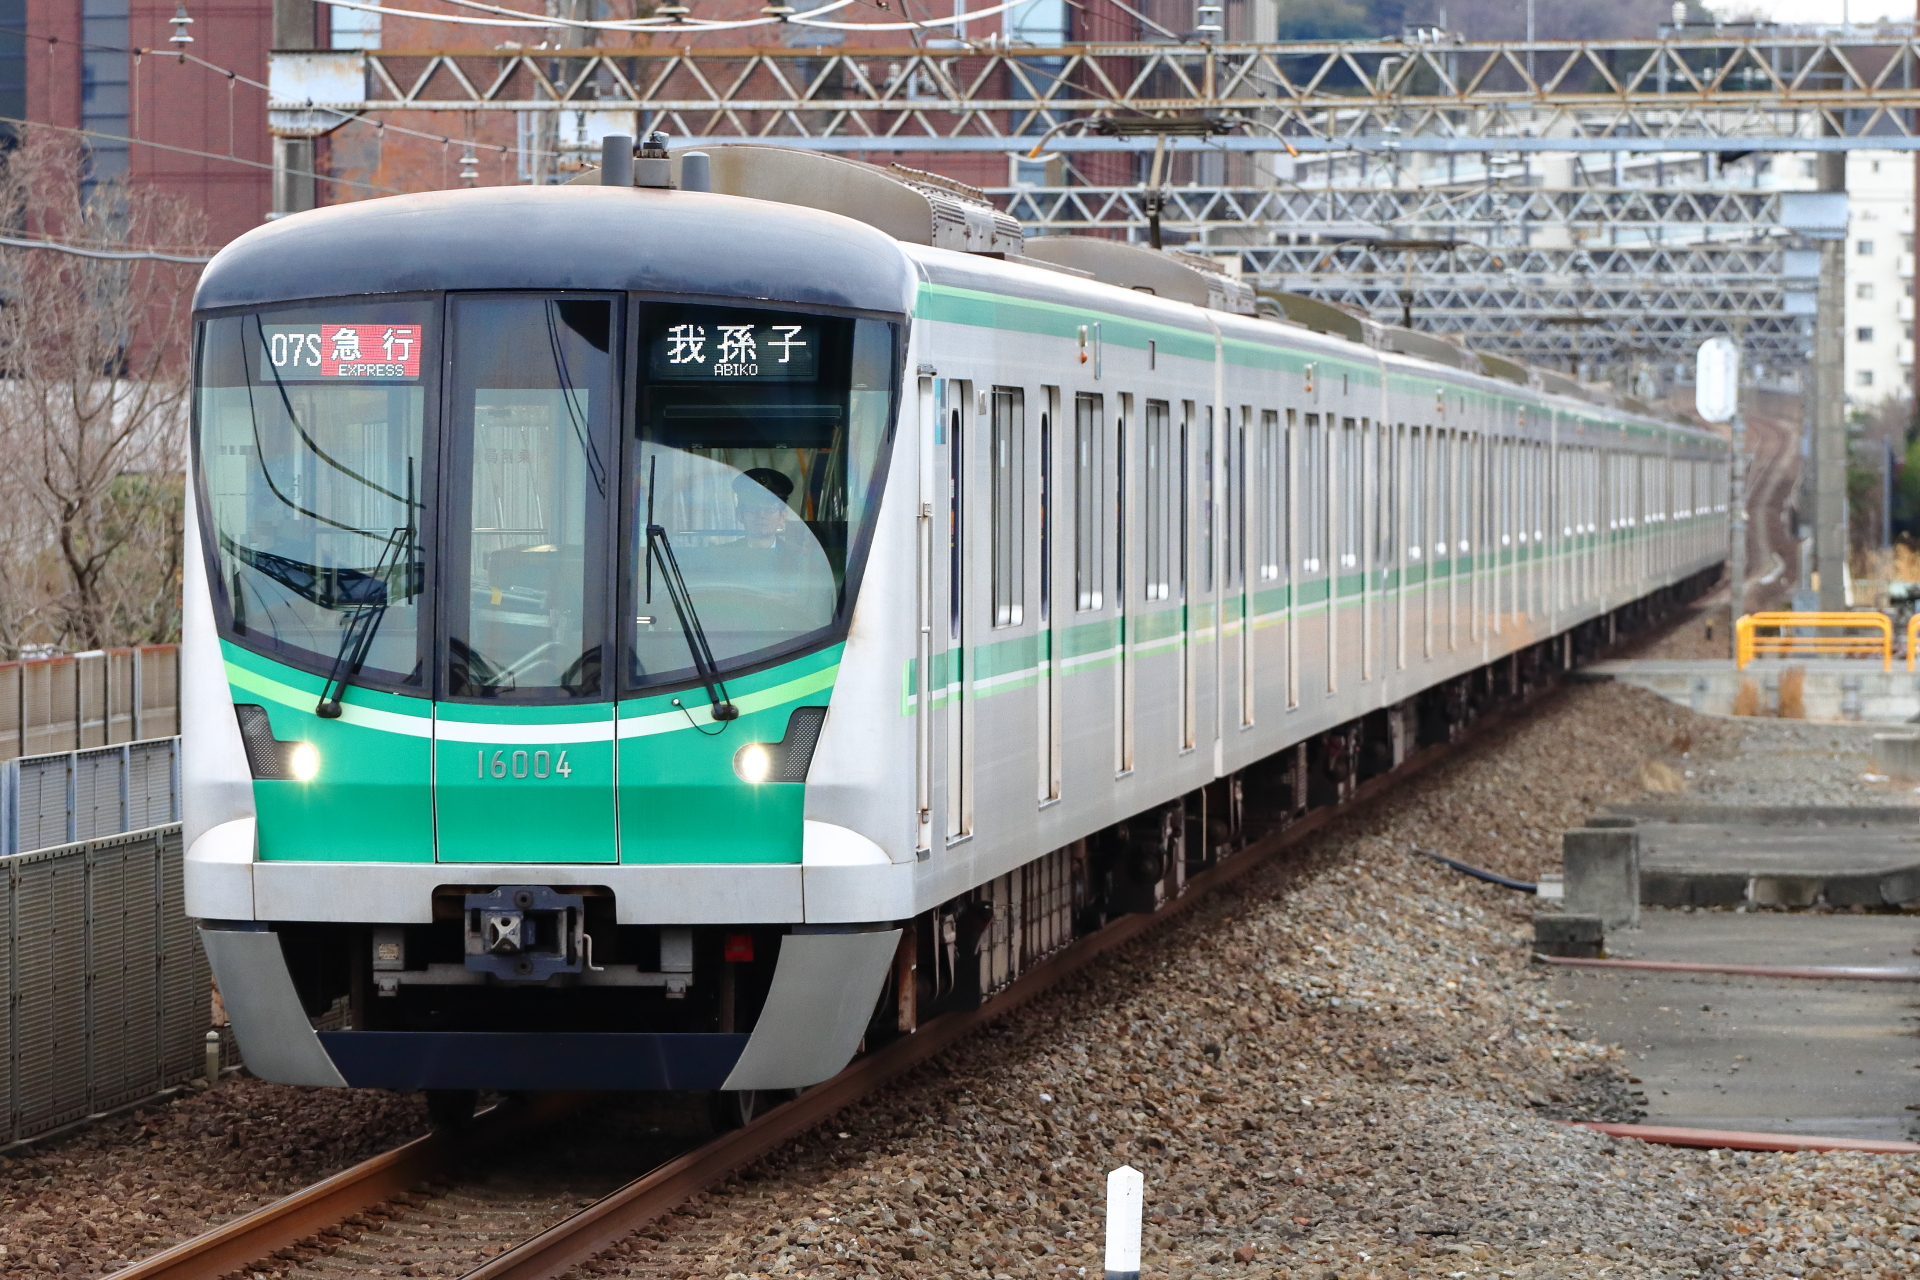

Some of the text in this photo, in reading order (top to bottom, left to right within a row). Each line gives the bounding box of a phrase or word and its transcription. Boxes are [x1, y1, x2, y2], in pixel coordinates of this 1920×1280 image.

[271, 333, 322, 367] 07S
[330, 327, 415, 361] 急行
[667, 324, 807, 364] 我孫子
[338, 363, 404, 376] EXPRESS
[713, 363, 758, 376] ABIKO
[477, 750, 572, 779] 16004
